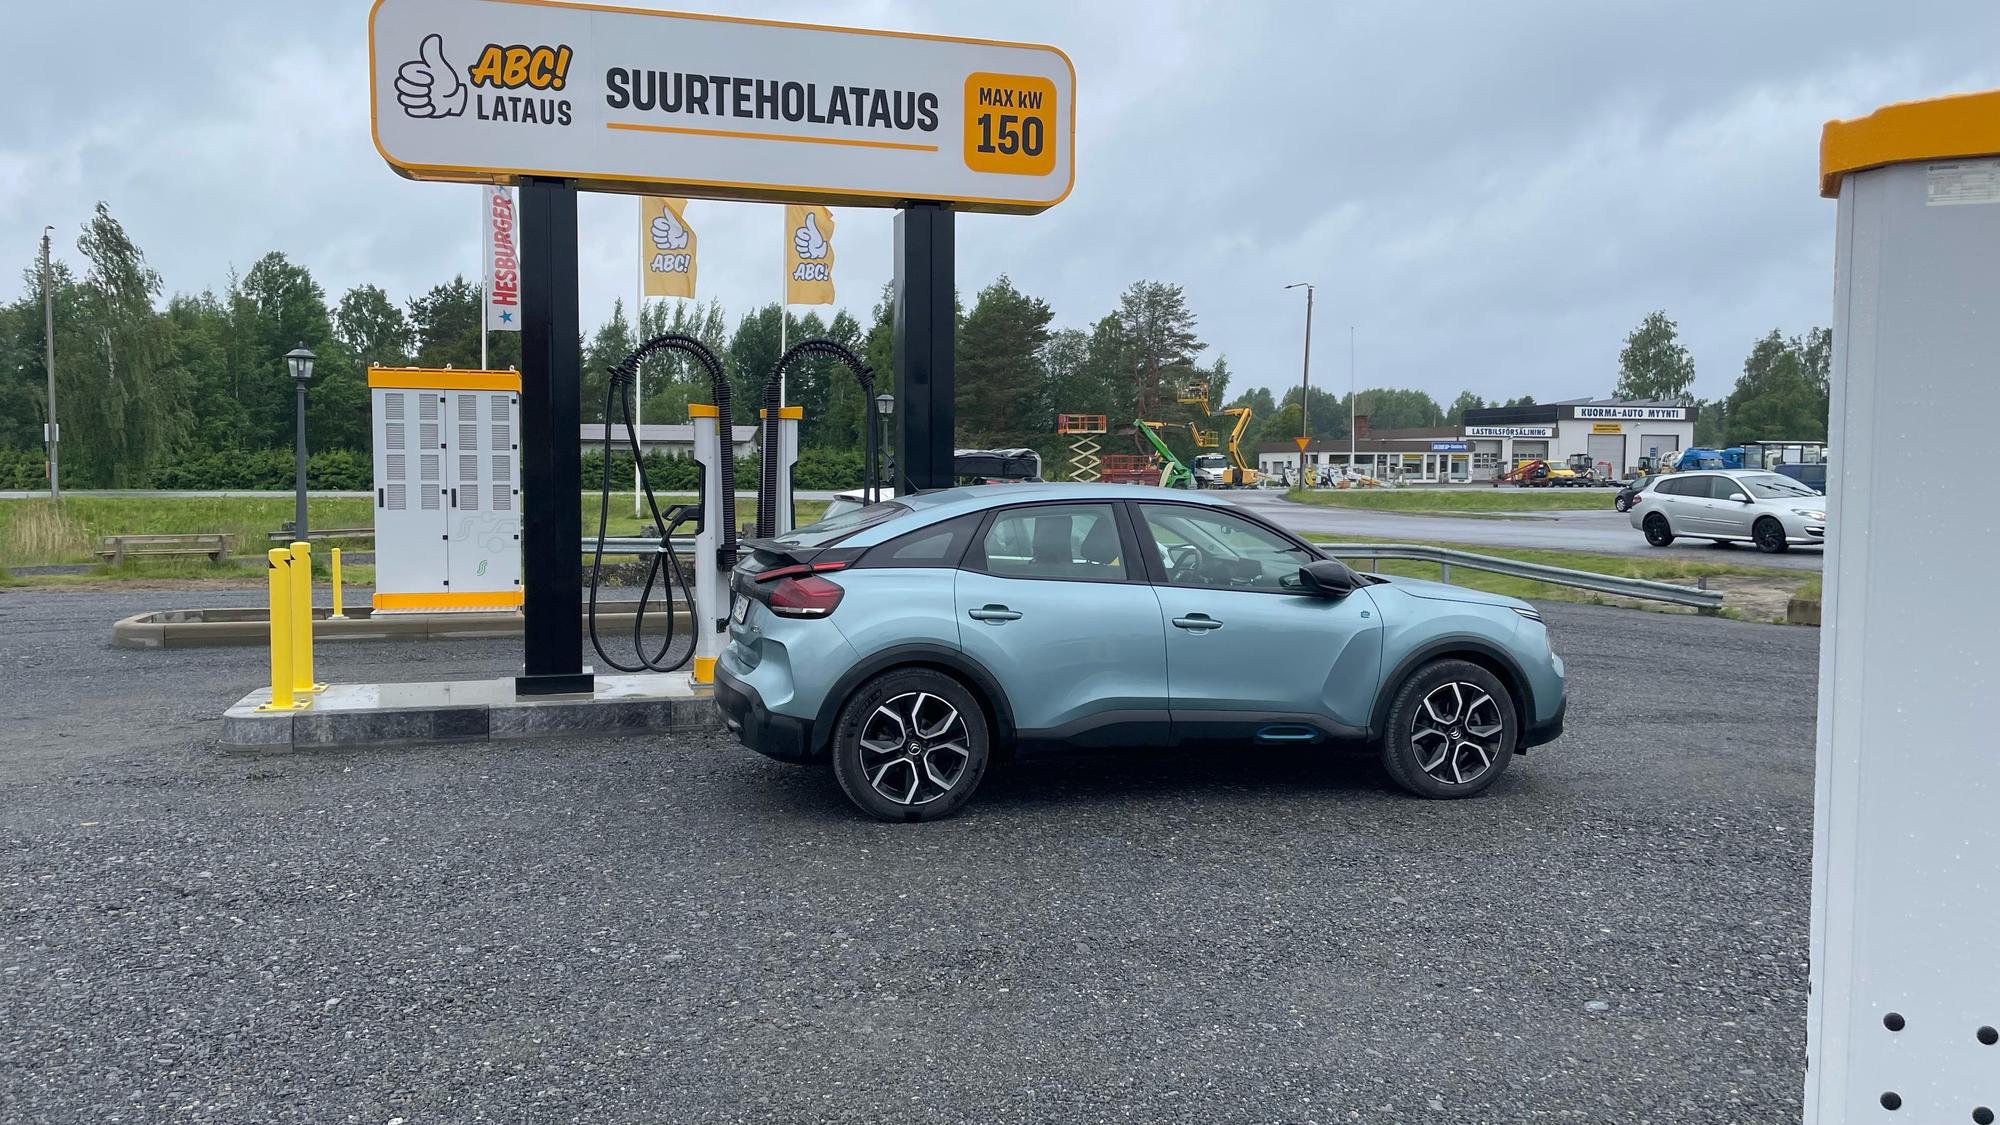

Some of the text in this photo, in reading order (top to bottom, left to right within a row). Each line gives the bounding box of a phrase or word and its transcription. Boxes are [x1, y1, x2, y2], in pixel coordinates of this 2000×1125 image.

[468, 43, 573, 91] ABC!
[477, 94, 572, 126] LATAUS
[606, 67, 939, 132] SUURTEHOLATAUS
[979, 87, 1043, 109] MAX kW
[977, 113, 1044, 156] 150
[491, 194, 518, 306] HESBURGER
[650, 253, 691, 273] ABC!
[793, 263, 829, 281] ABC!
[1581, 408, 1679, 418] KUORMA-AUTO MYYNTI
